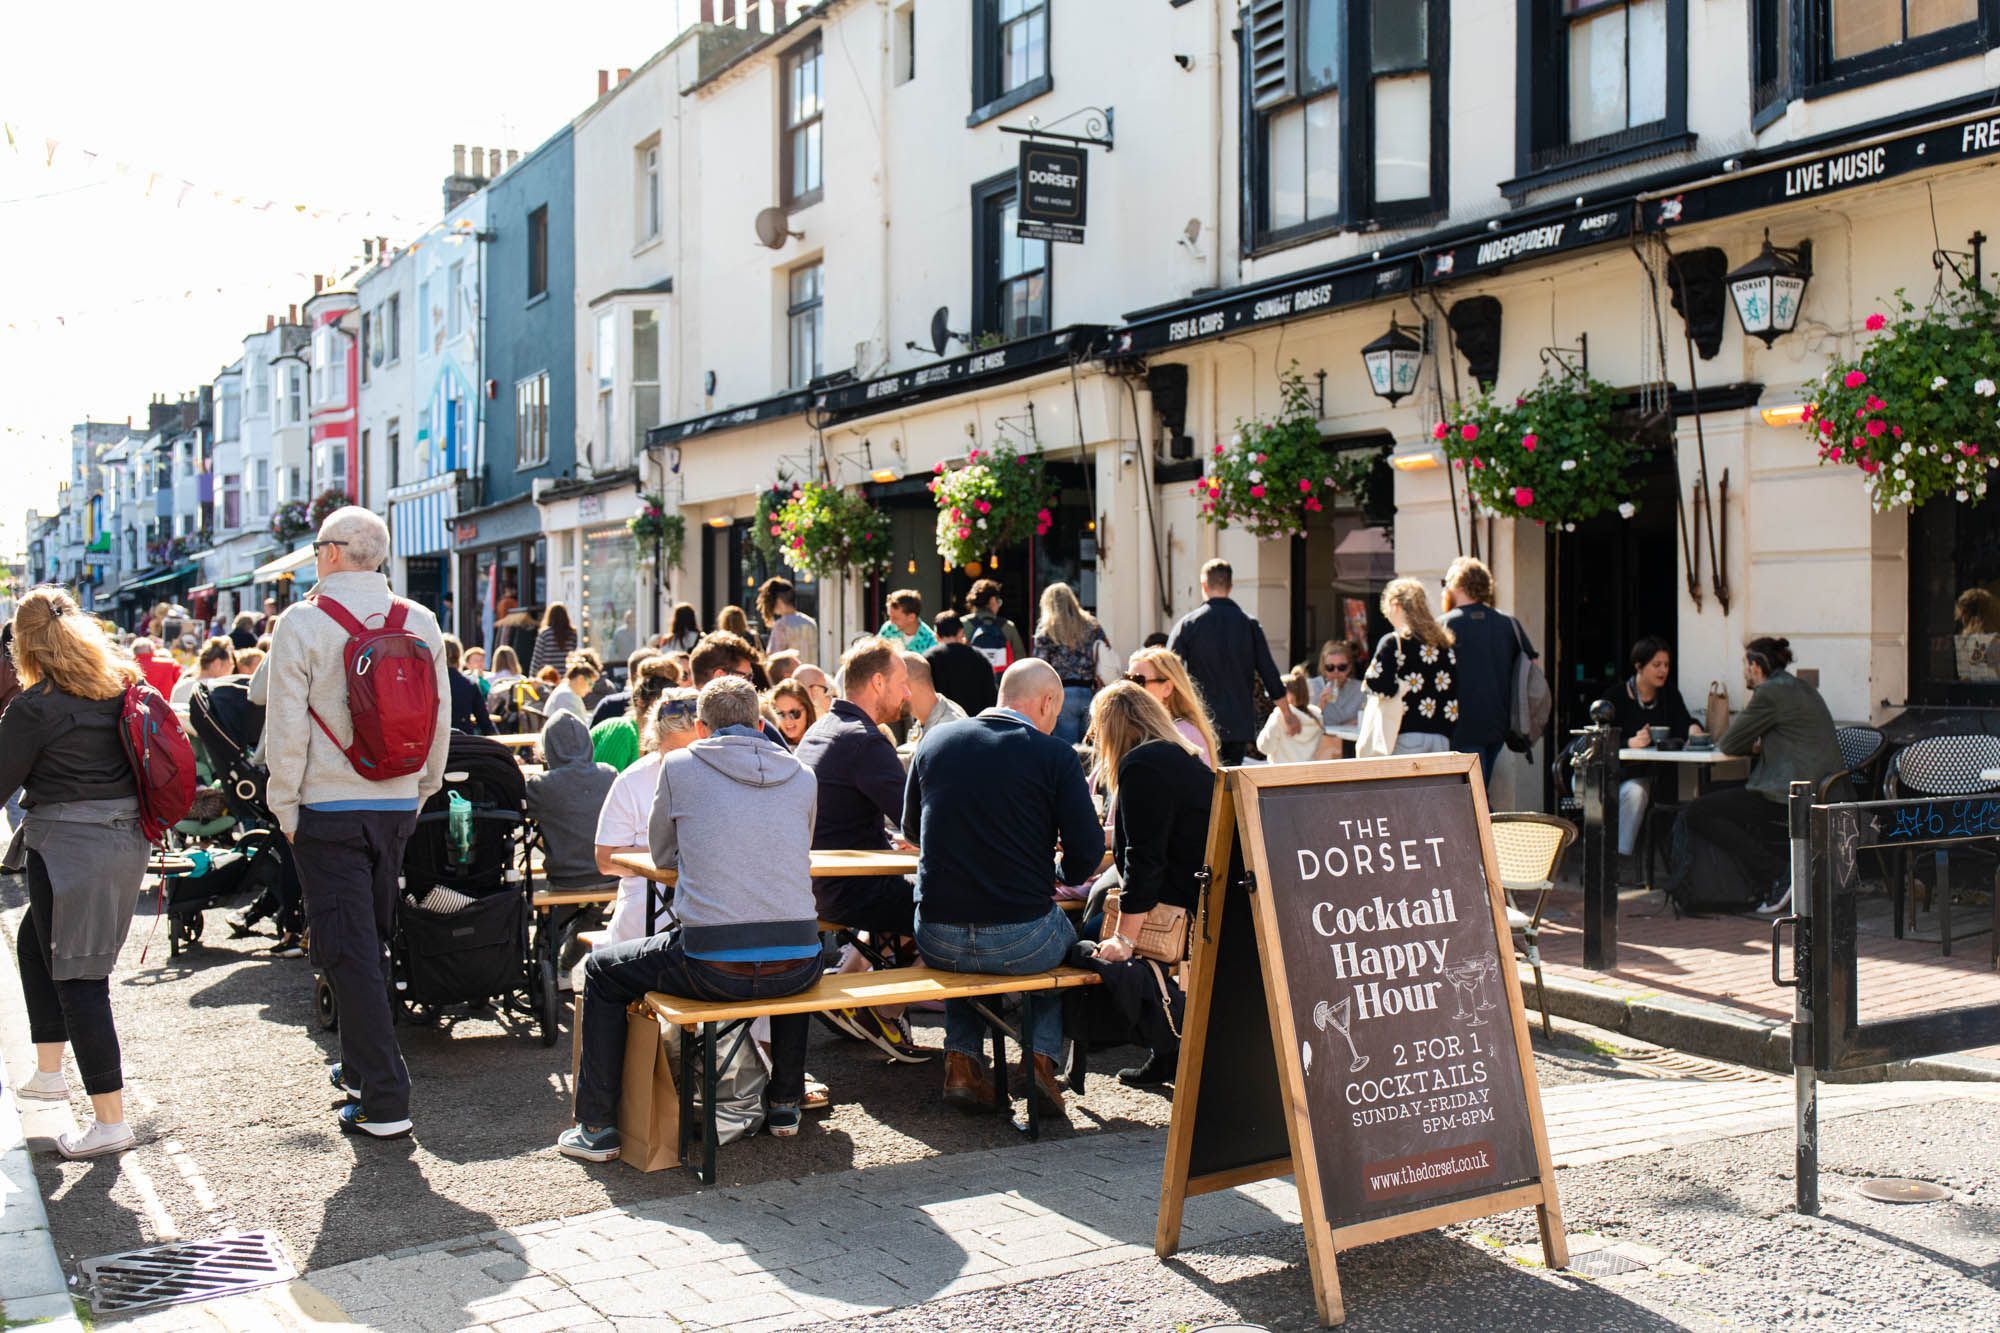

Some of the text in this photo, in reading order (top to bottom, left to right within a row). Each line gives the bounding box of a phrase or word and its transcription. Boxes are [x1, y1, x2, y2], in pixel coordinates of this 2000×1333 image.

[1028, 170, 1079, 188] DORSET
[1785, 147, 1886, 196] LIVE MUSIC
[1477, 224, 1566, 266] INDEPENDENT
[1253, 284, 1333, 320] SUNDAY ROASTS
[1735, 279, 1767, 293] DORSET
[1775, 278, 1801, 290] DORSET
[1169, 311, 1225, 341] FISH & CHIPS
[1339, 817, 1391, 839] THE
[1297, 837, 1445, 881] DORSET
[1311, 888, 1459, 937] Cocktail
[1330, 937, 1450, 980] Happy
[1353, 980, 1442, 1020] Hour
[1393, 1032, 1483, 1067] 2 FOR 1
[1345, 1061, 1488, 1105] COCKTAILS
[1352, 1087, 1491, 1127] SUNDAY-FRIDAY
[1422, 1106, 1496, 1135] 5PM-8PM
[1370, 1151, 1489, 1191] www.thedorset.co.uk
